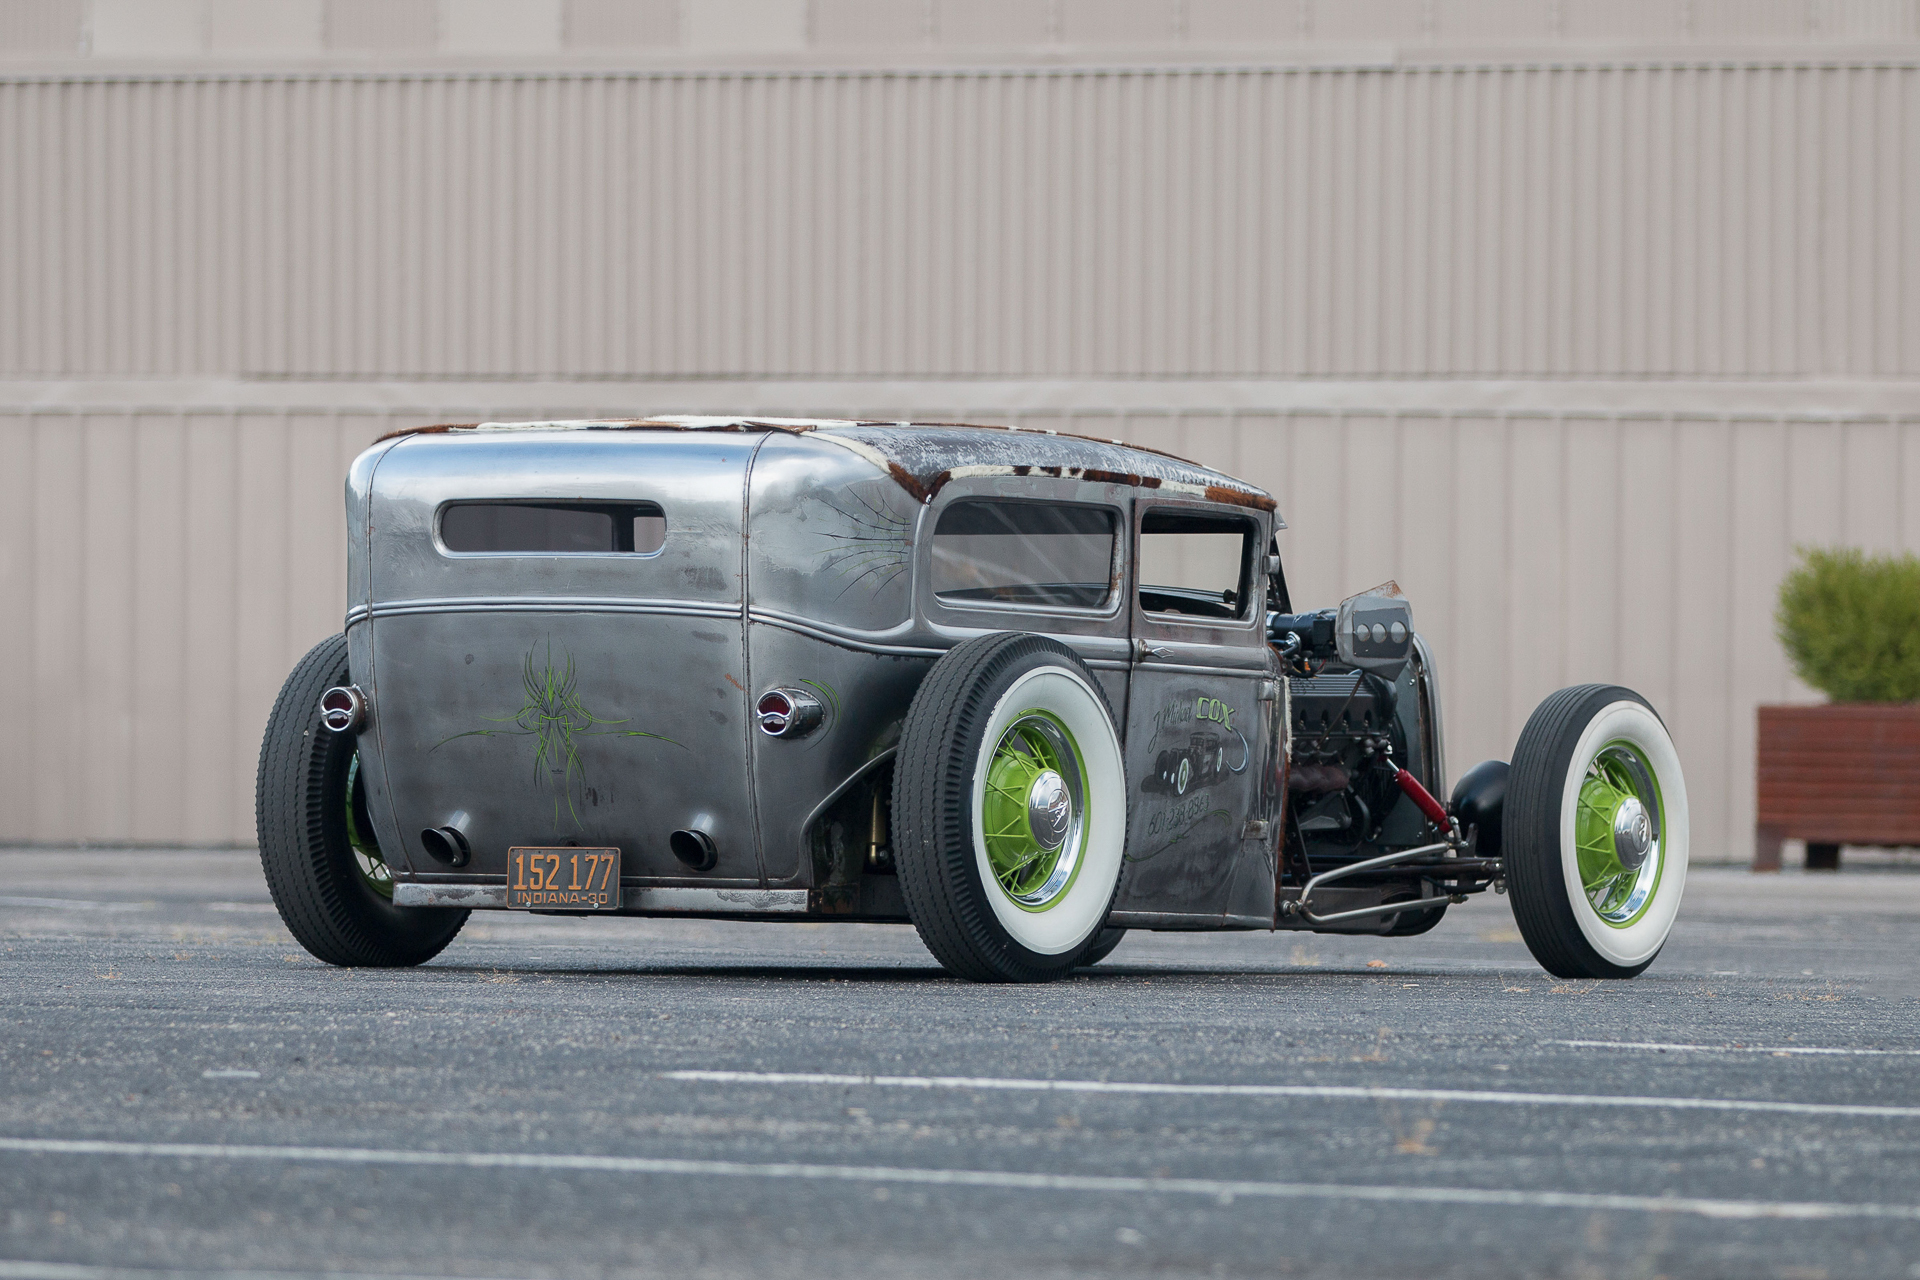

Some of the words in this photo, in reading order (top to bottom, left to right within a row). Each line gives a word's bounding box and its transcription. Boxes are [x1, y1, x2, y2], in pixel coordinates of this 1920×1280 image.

[1196, 697, 1235, 732] COX
[513, 854, 560, 890] 152
[568, 854, 614, 890] 177
[517, 892, 608, 904] INDIANA-30
